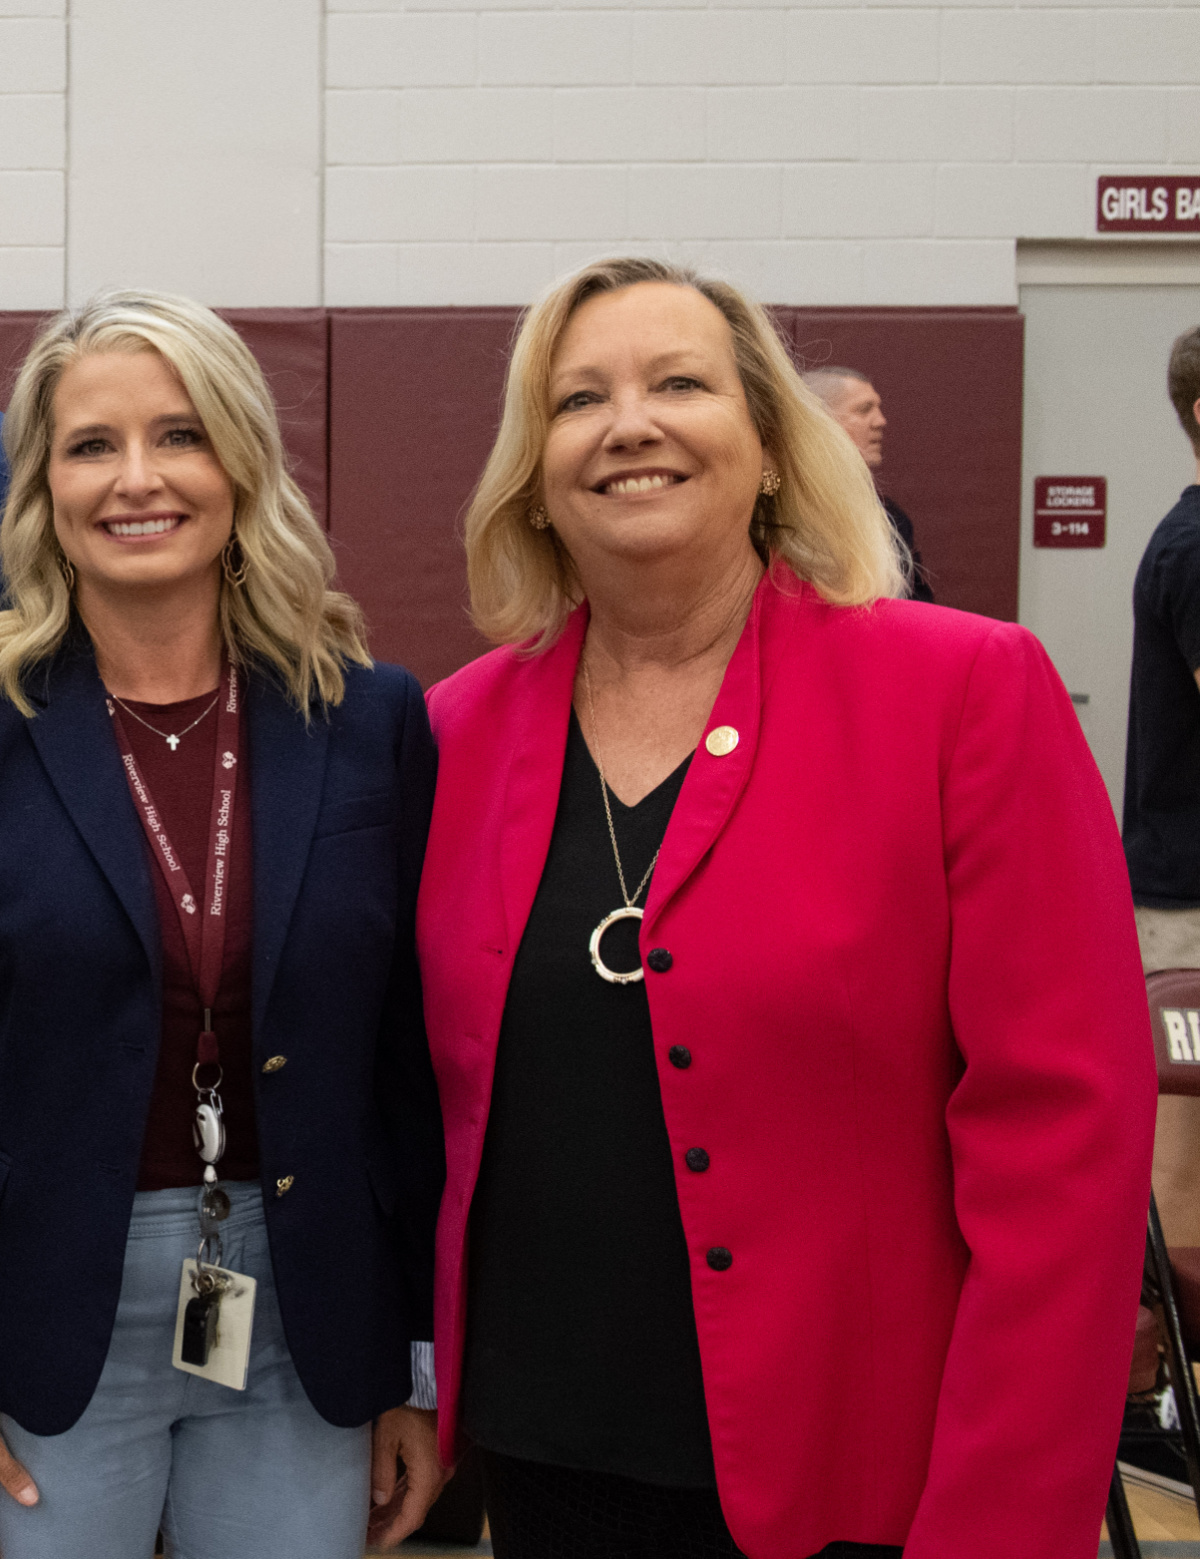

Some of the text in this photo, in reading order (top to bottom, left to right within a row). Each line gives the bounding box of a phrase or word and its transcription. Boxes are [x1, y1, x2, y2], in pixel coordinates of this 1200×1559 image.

[1102, 187, 1168, 220] GIRLS
[1046, 497, 1095, 507] LOCKERS
[1047, 486, 1094, 496] STORAGE
[1051, 522, 1089, 536] 3-114
[122, 753, 180, 872] Riverview High School
[210, 790, 231, 916] Riverview High School
